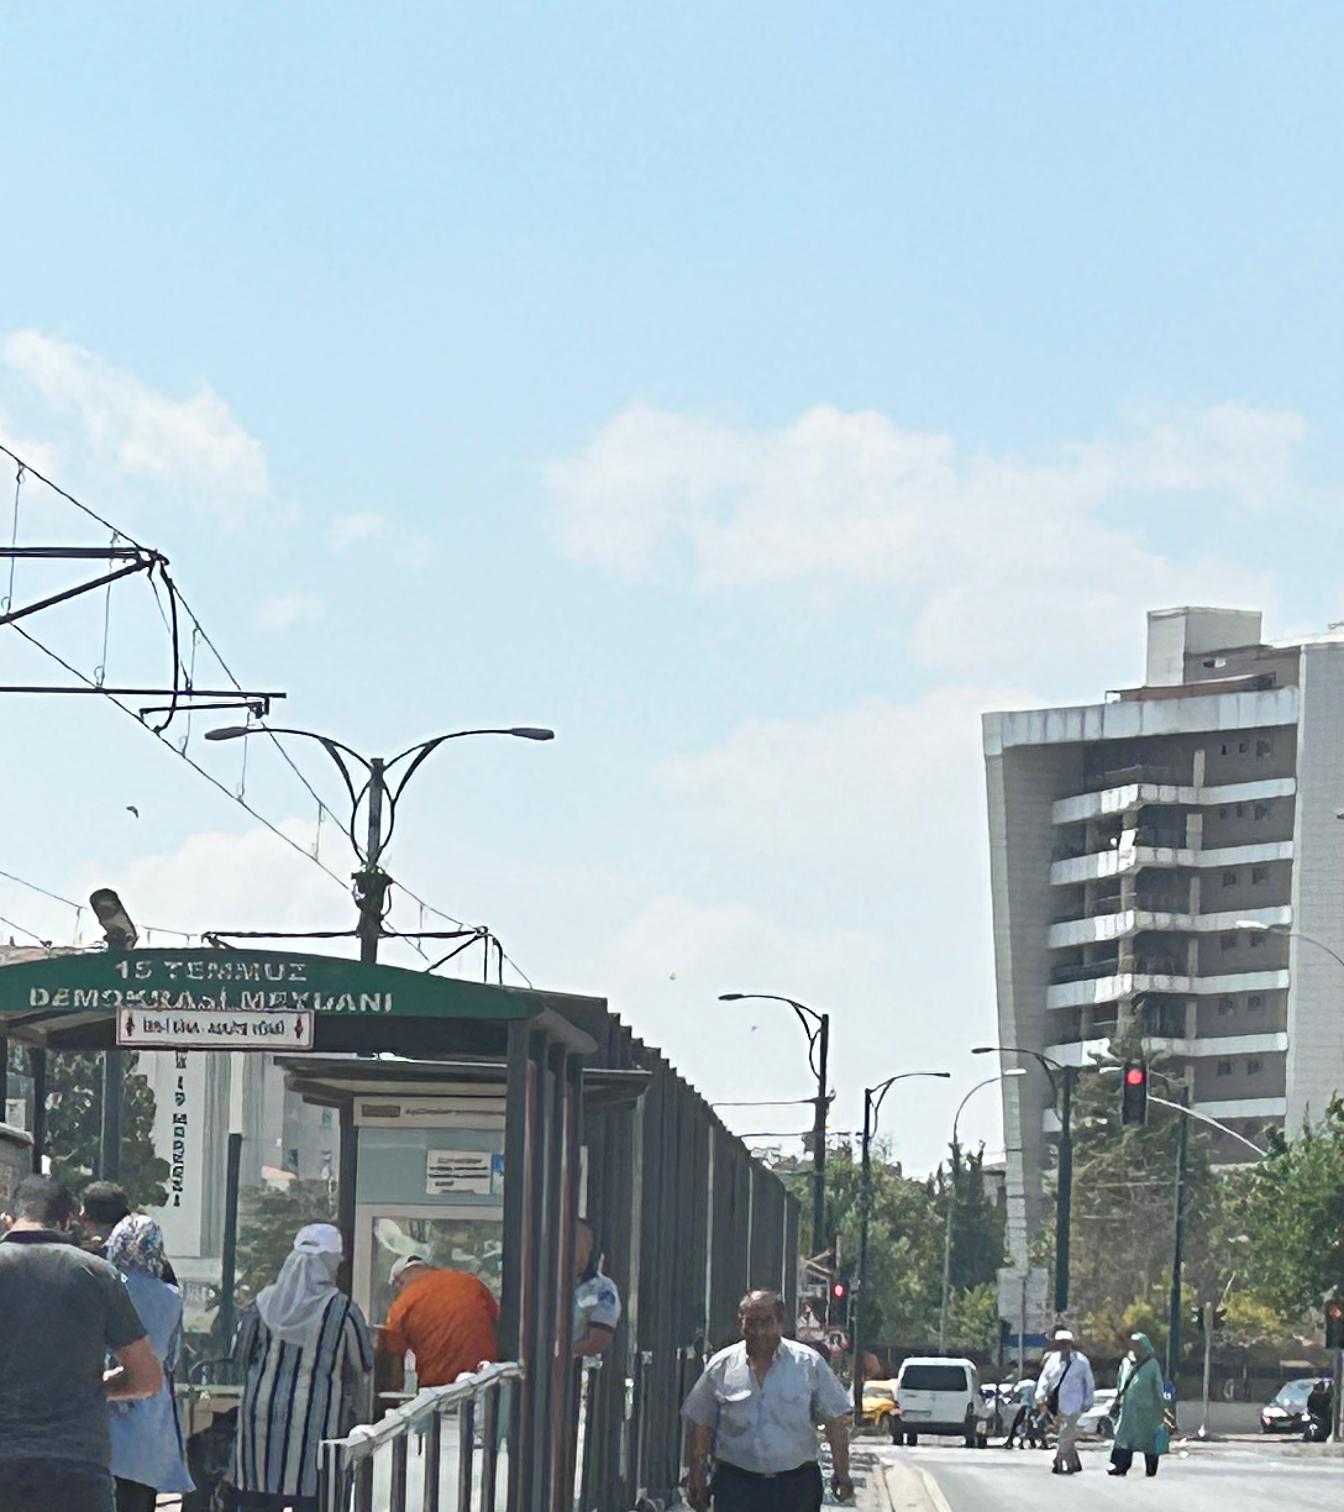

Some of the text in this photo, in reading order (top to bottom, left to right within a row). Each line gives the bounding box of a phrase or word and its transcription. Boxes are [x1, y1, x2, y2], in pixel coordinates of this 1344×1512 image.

[115, 960, 307, 982] 15 TEMMUZ
[241, 990, 393, 1012] MEYDANI
